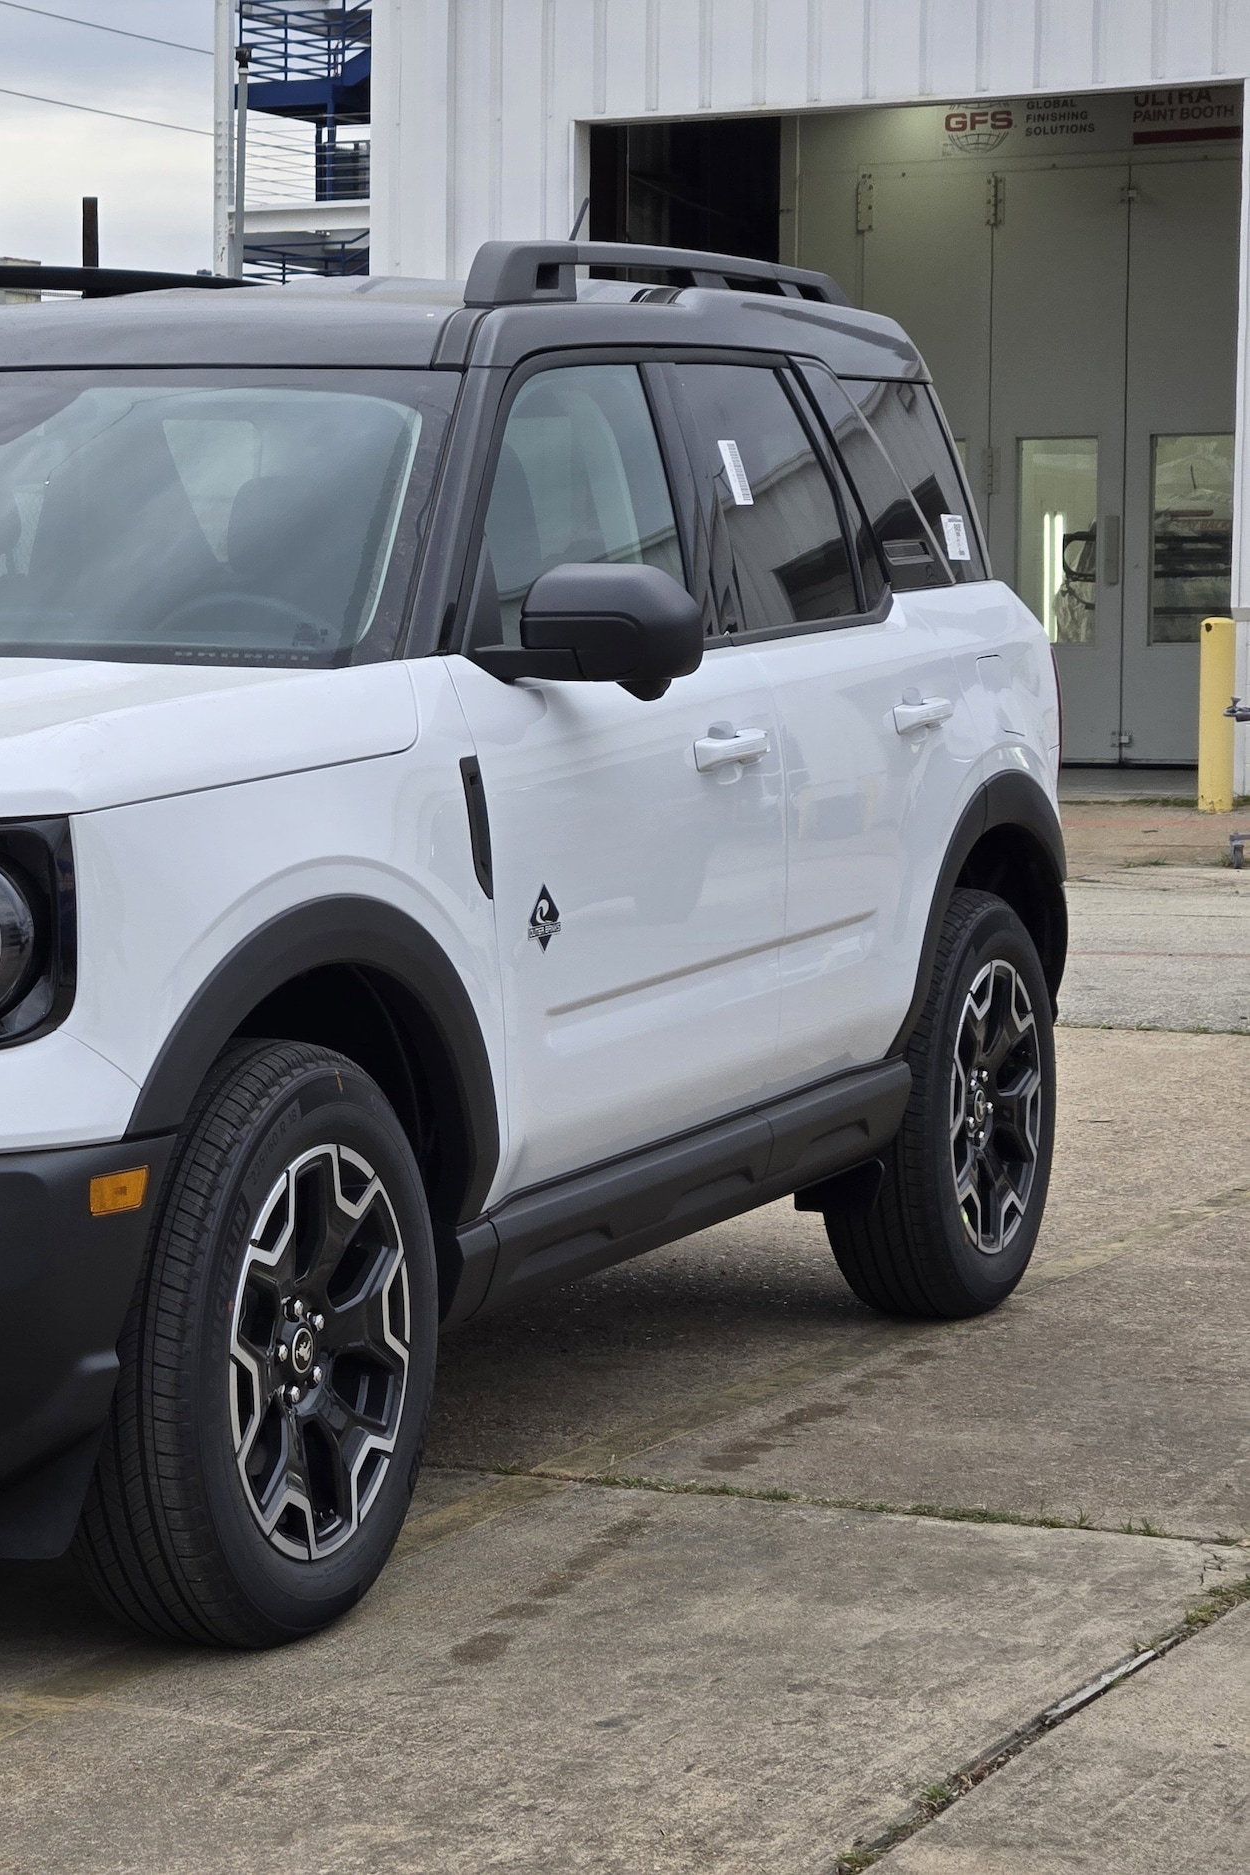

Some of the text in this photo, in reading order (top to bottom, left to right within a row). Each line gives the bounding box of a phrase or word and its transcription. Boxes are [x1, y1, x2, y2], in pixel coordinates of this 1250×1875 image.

[1026, 99, 1077, 110] GLOBAL
[1025, 110, 1089, 123] FINISHING
[1133, 104, 1235, 123] PAINT BOOTH
[945, 110, 1013, 132] GFS
[1025, 123, 1096, 137] SOLUTIONS
